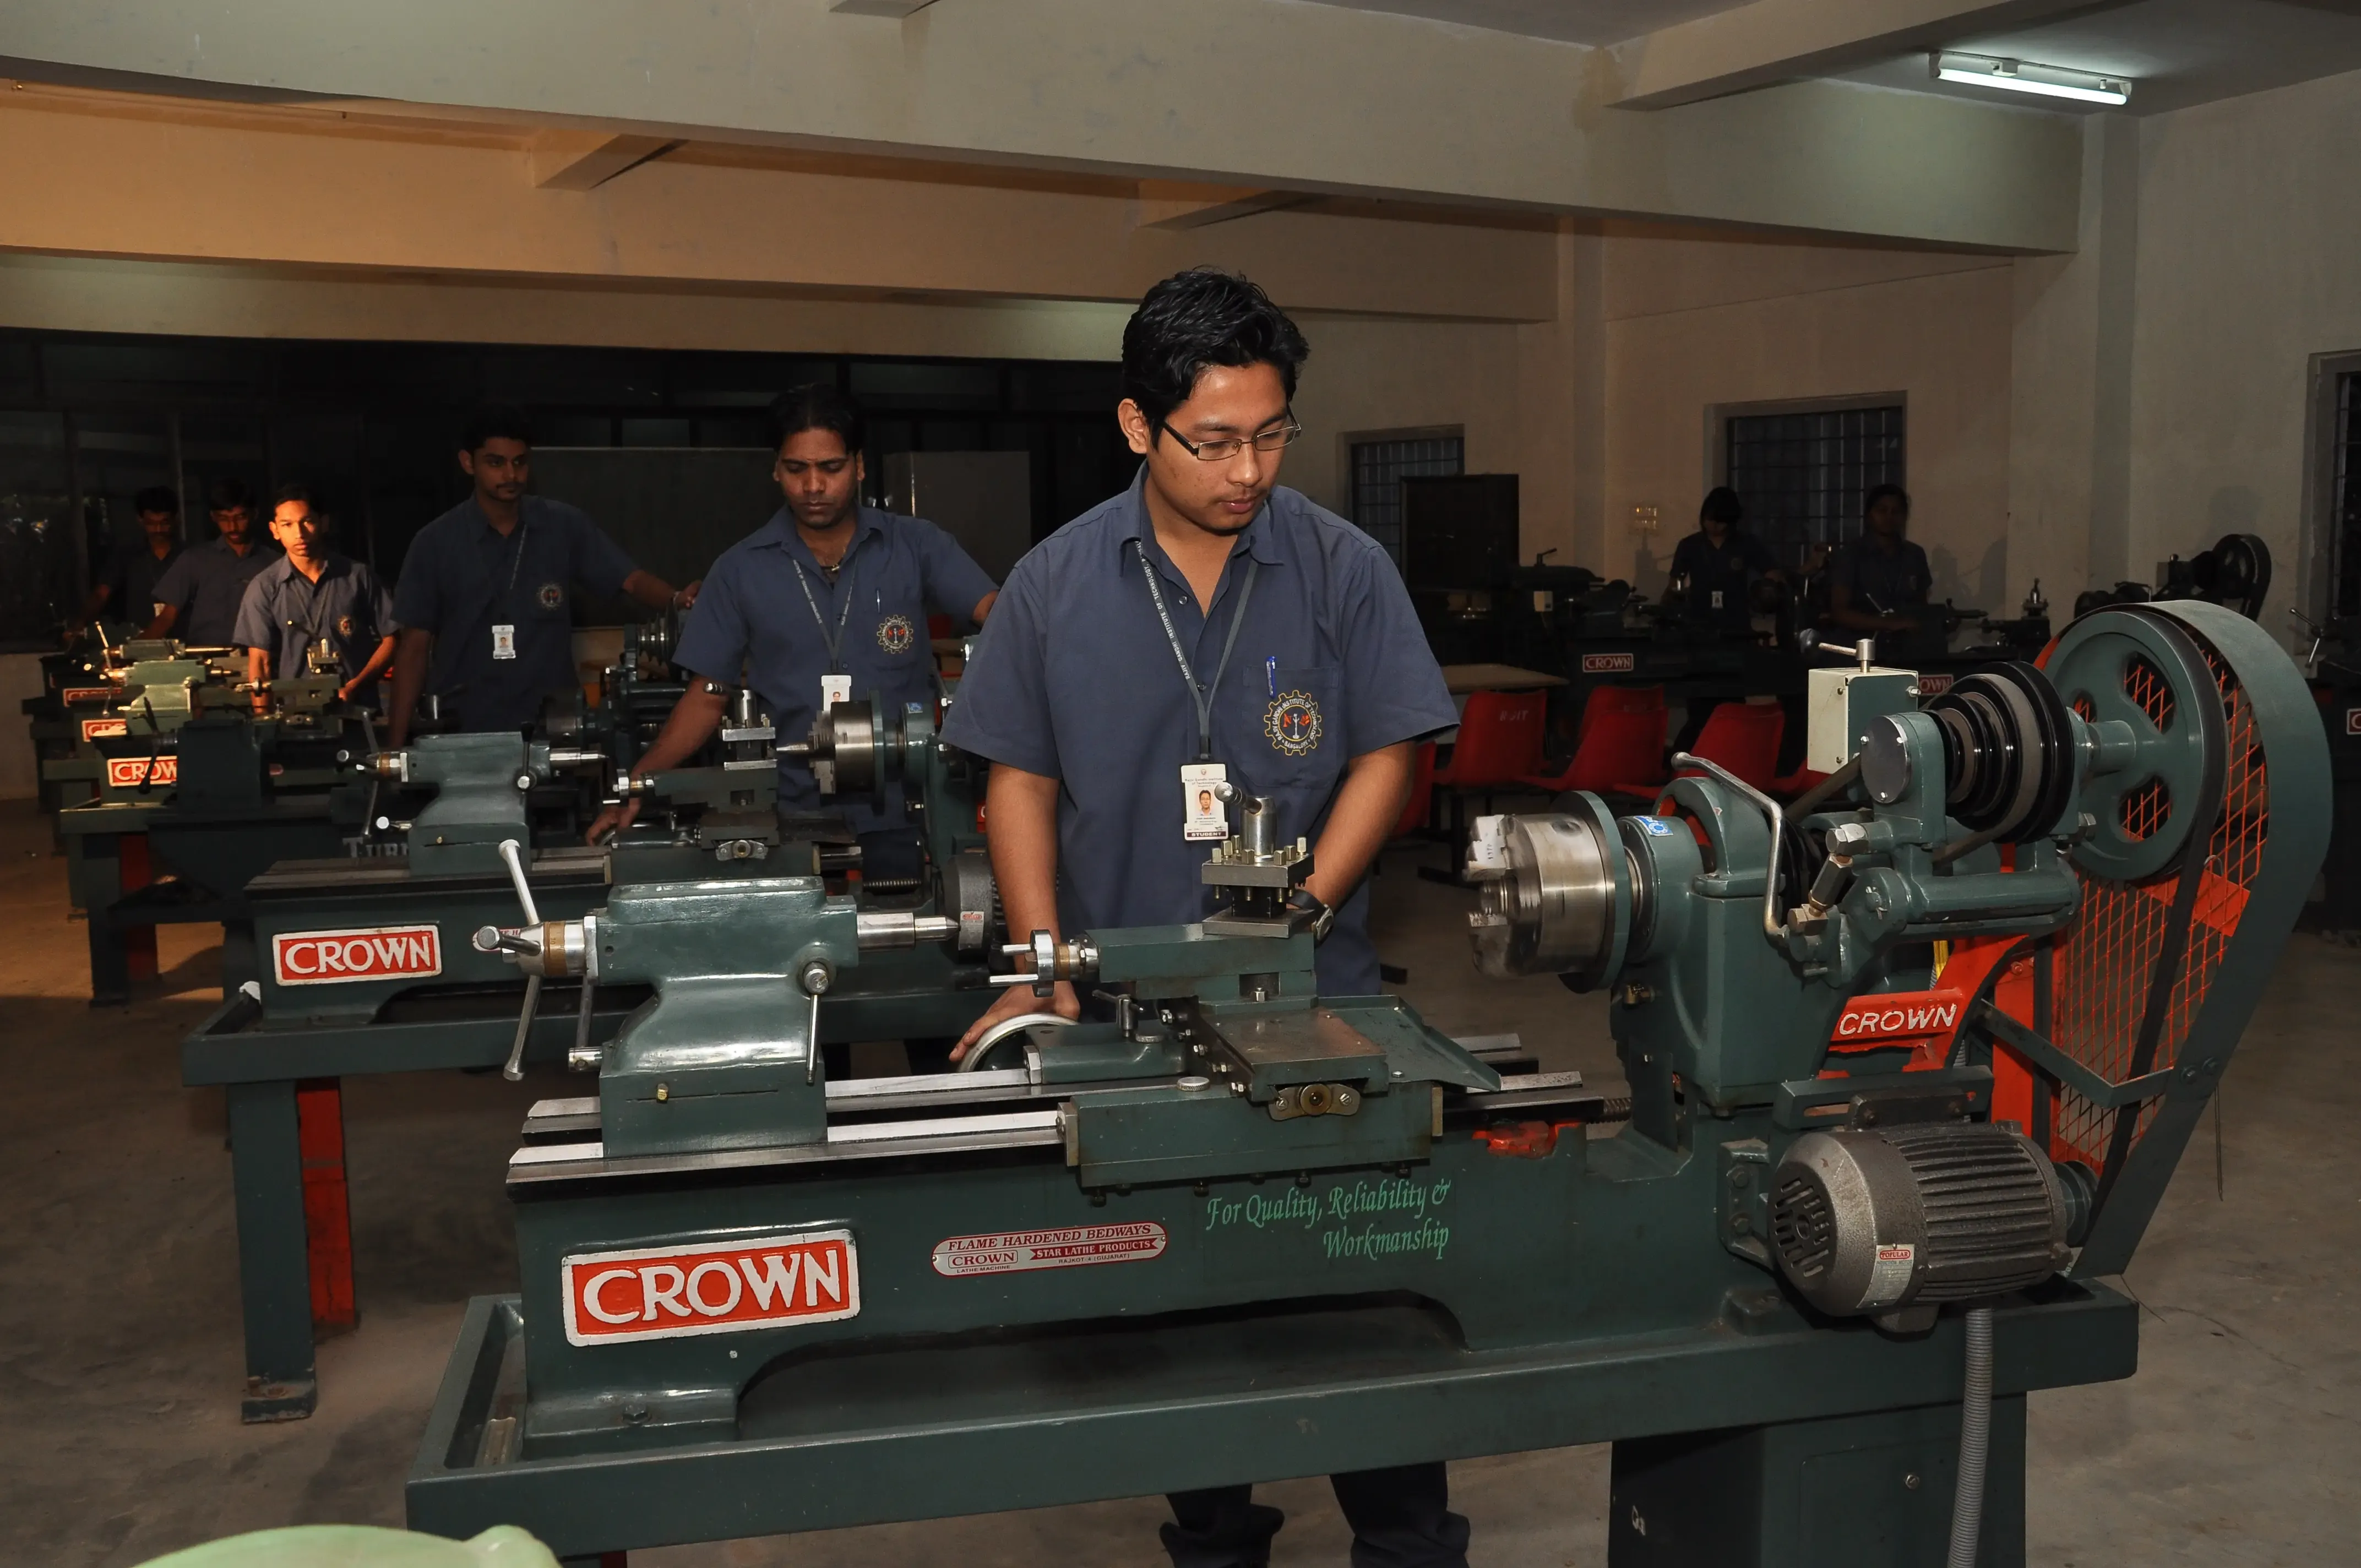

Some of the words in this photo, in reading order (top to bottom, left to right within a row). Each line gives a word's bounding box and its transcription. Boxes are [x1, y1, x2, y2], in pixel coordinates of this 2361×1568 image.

[1161, 612, 1174, 639] INSTITUTE
[1172, 641, 1183, 661] GANDHI
[1180, 665, 1190, 679] RAJIV
[1586, 657, 1630, 668] CROWN
[1282, 698, 1304, 709] INSTITUTE
[1272, 706, 1283, 725] GANDHI
[1309, 707, 1318, 740] TECHNOLOGY
[1272, 726, 1283, 741] RAJIV
[1284, 741, 1308, 749] BANGALORE
[285, 935, 431, 974] CROWN
[1839, 1003, 1957, 1035] CROWN
[1206, 1197, 1242, 1231] For
[1246, 1187, 1323, 1229] Quality,
[1328, 1178, 1428, 1219] Reliability
[1432, 1178, 1451, 1205] &
[948, 1238, 998, 1251] FLAME
[1002, 1231, 1081, 1246] HARDENED
[1086, 1224, 1151, 1239] BEDWAYS
[1323, 1218, 1449, 1260] Workmanship
[952, 1252, 1014, 1266] CROWN
[1036, 1248, 1062, 1258] STAR
[1065, 1244, 1096, 1255] LATHE
[1098, 1240, 1151, 1252] PRODUCTS
[583, 1250, 841, 1324] CROWN
